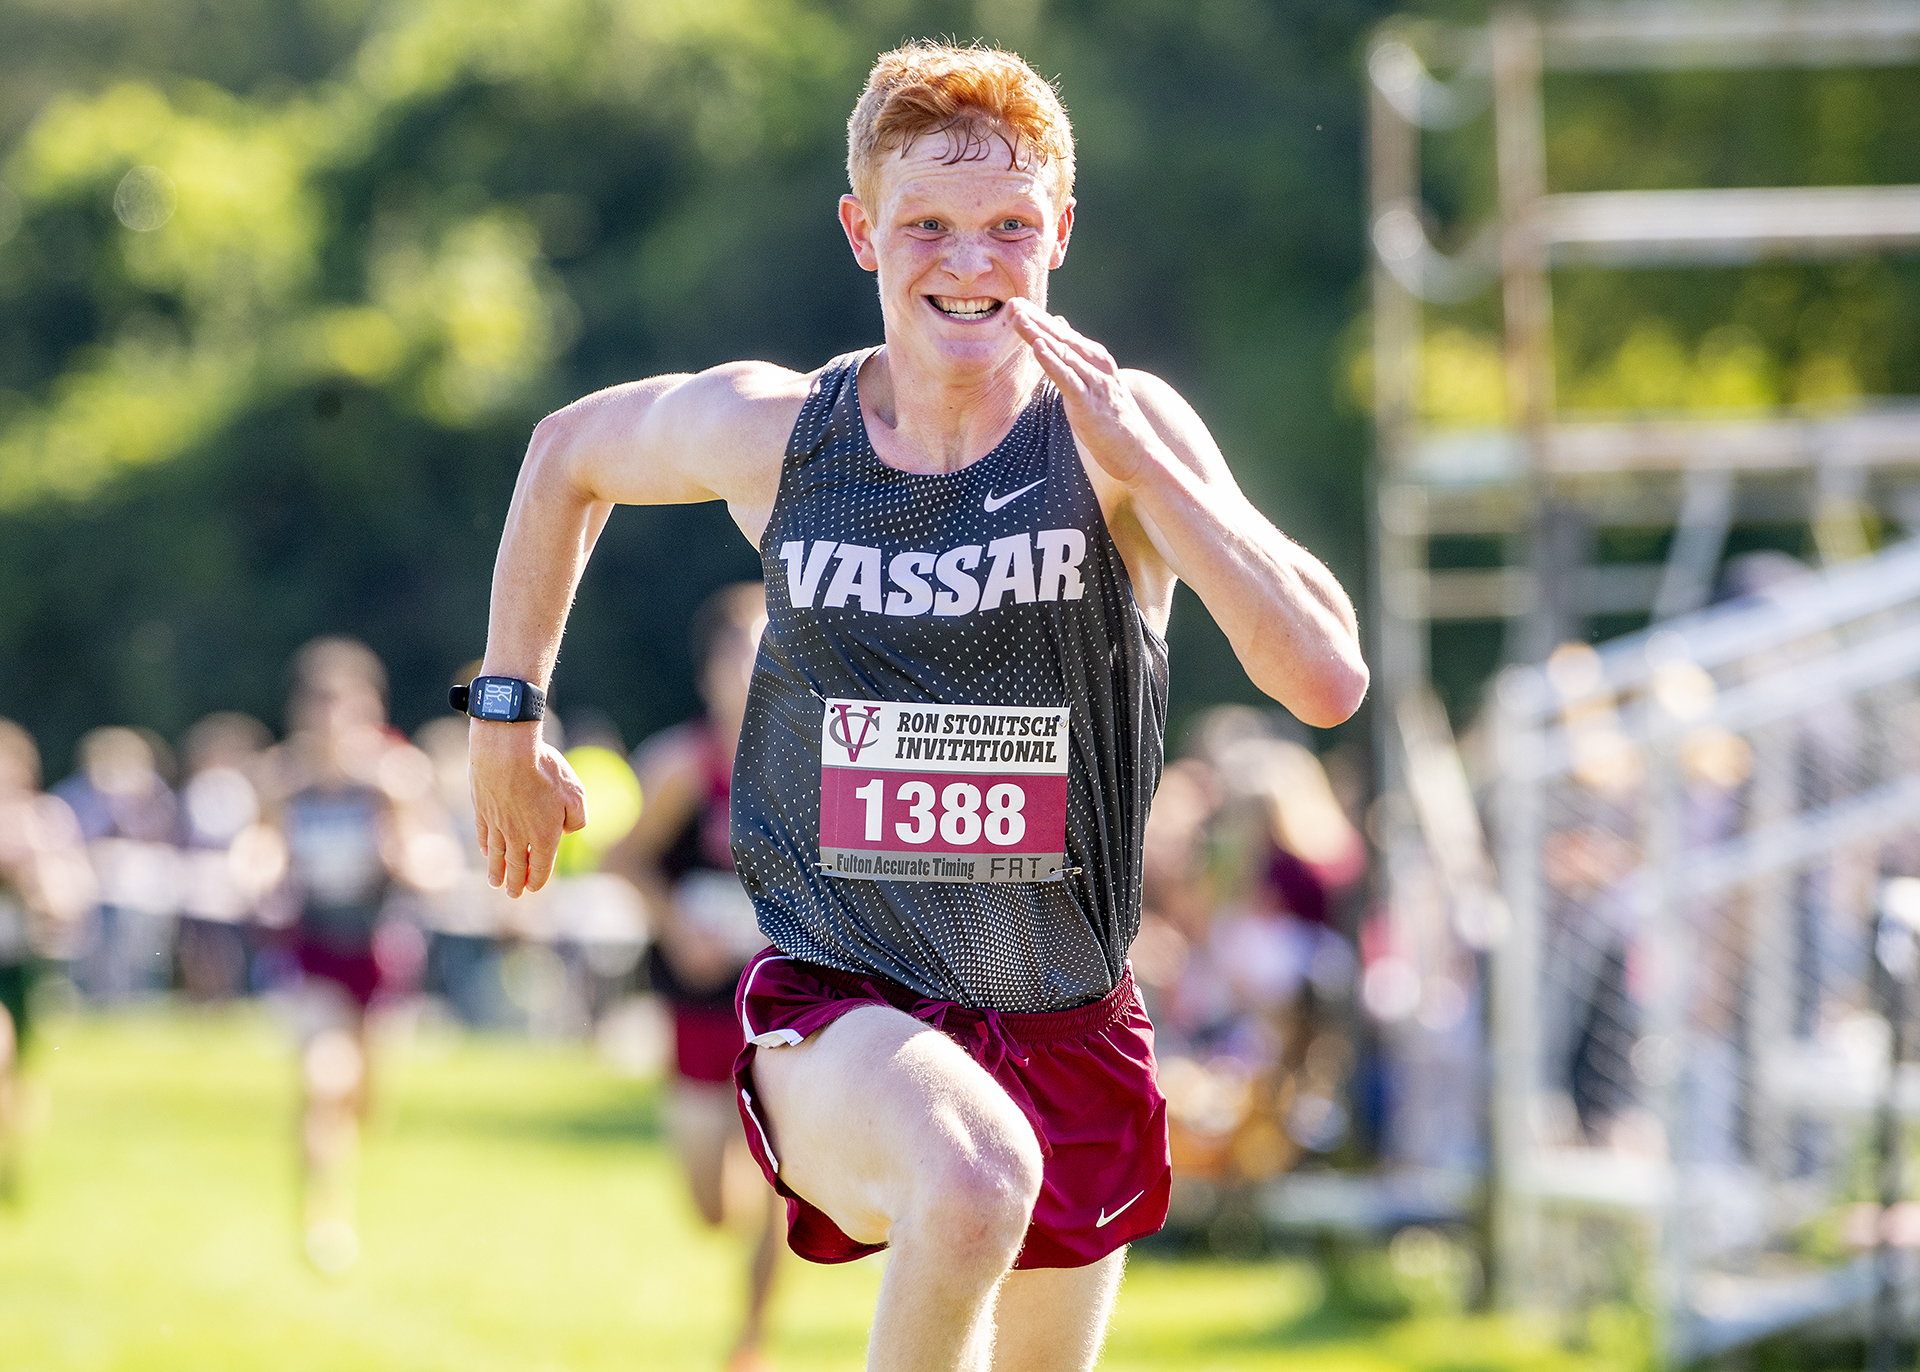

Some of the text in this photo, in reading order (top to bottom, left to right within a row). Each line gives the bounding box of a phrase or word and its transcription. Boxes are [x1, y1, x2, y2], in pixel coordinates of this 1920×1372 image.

[779, 528, 1086, 617] VASSAR
[897, 712, 1058, 736] RON STONITSCH
[895, 737, 1058, 763] INVITATIONAL
[855, 779, 1026, 845] 1388
[836, 853, 1042, 880] Fulton Accurate Timing FAT
